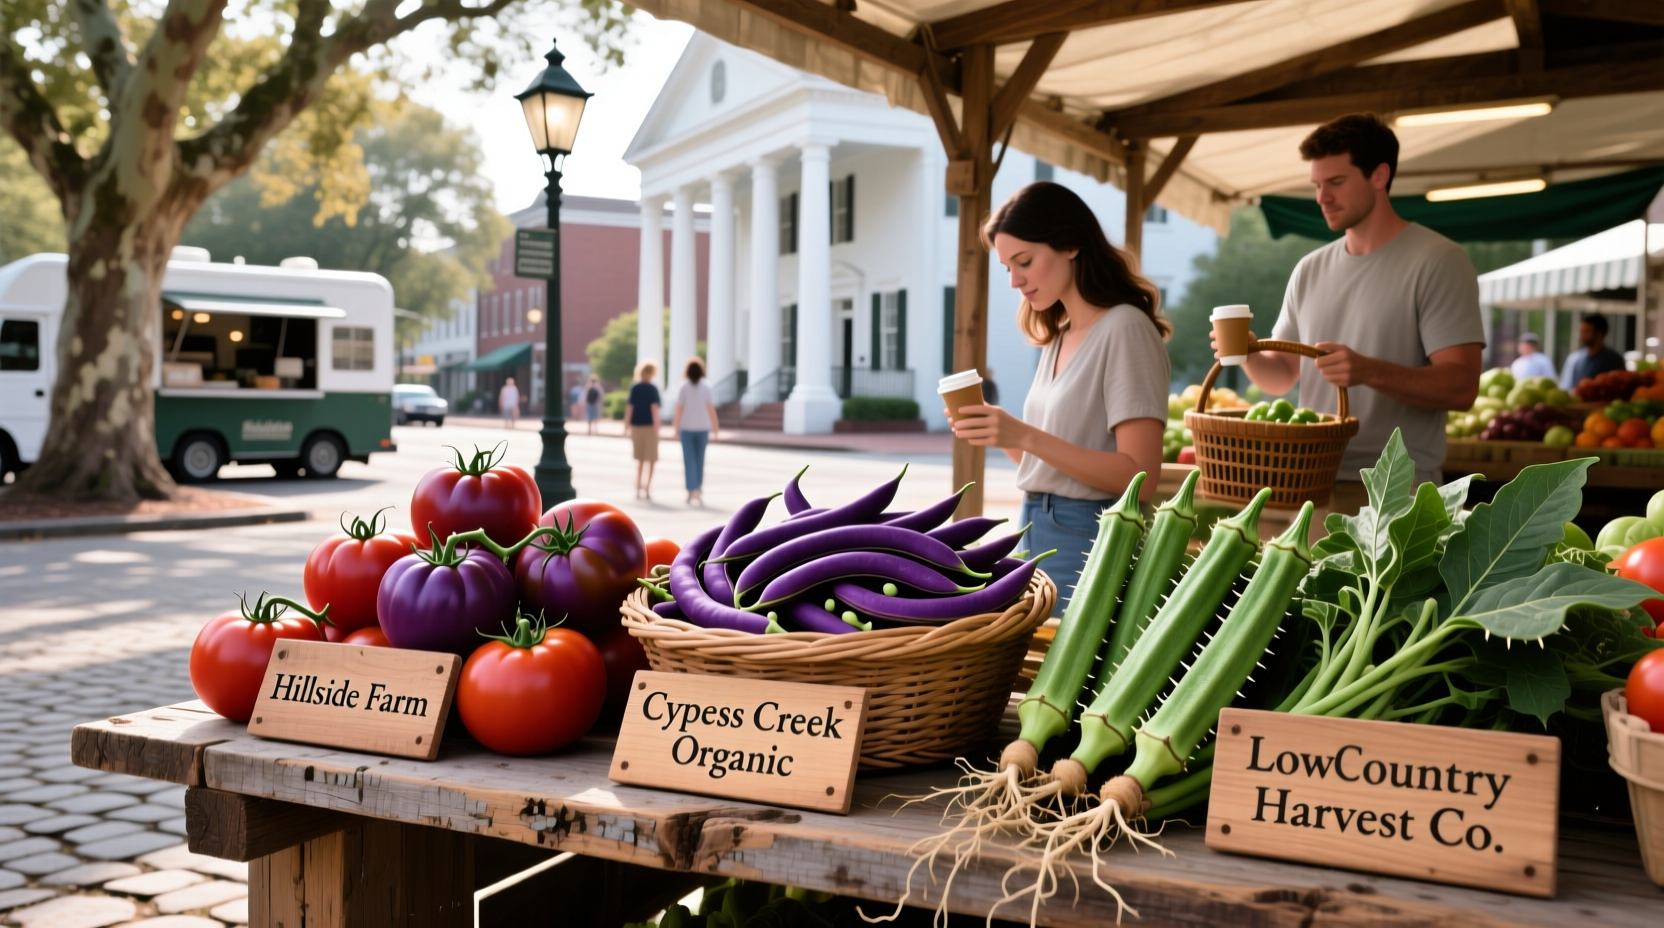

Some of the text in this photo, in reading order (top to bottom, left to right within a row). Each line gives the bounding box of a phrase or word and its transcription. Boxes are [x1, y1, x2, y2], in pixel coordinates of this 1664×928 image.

[270, 673, 428, 717] Hillside Farm
[642, 691, 844, 740] Cypess Creek
[671, 735, 794, 779] Organic
[1246, 735, 1512, 810] LowCountry
[1251, 786, 1504, 853] Harvest Co.
